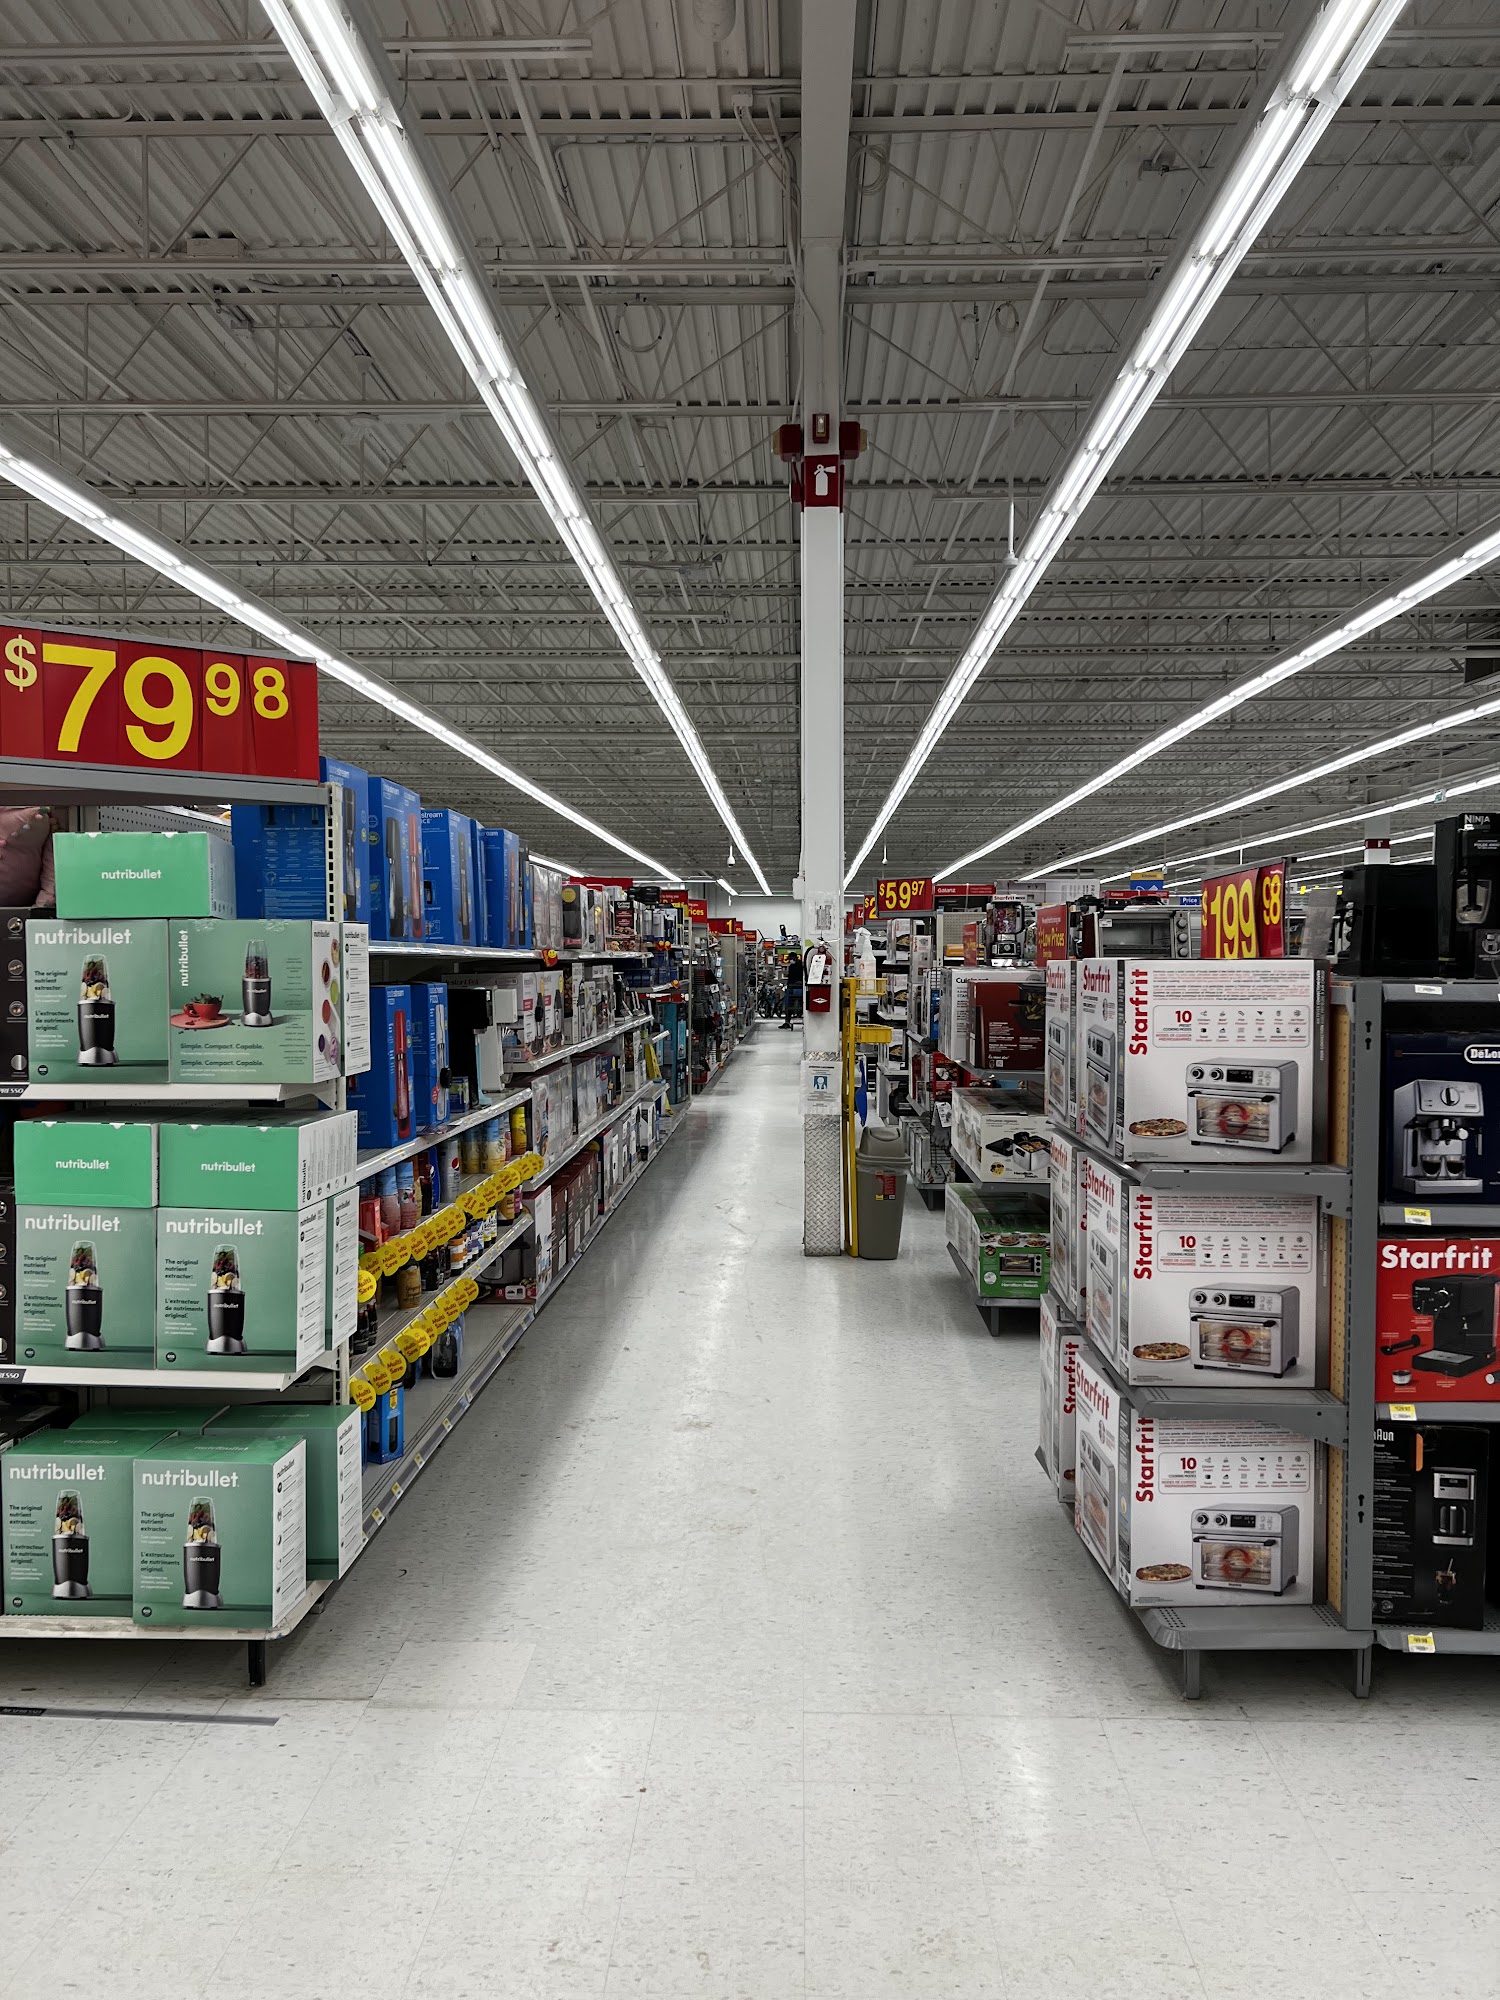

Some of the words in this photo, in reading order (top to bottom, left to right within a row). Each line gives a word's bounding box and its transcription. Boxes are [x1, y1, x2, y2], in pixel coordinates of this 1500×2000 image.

[1464, 814, 1490, 825] NINJA
[101, 869, 162, 880] nutribullet
[34, 928, 132, 945] nutribullet
[178, 929, 189, 987] nutribullet
[1083, 965, 1110, 993] Starfrit
[1128, 969, 1148, 1055] Starfrit
[1175, 1010, 1192, 1023] 10
[55, 1159, 110, 1170] nutribullet
[201, 1162, 256, 1173] nutribullet
[1086, 1165, 1115, 1207] Starfrit
[25, 1213, 120, 1232] nutribullet
[166, 1217, 263, 1236] nutribullet
[1133, 1194, 1153, 1280] Starfrit
[1179, 1235, 1196, 1248] 10
[1381, 1244, 1493, 1269] Starfrit
[1063, 1342, 1079, 1414] Starfrit
[1076, 1361, 1110, 1420] Starfrit
[1135, 1417, 1154, 1503] Starfrit
[1180, 1457, 1197, 1470] 10
[9, 1463, 105, 1481] nutribullet
[142, 1469, 239, 1488] nutribullet
